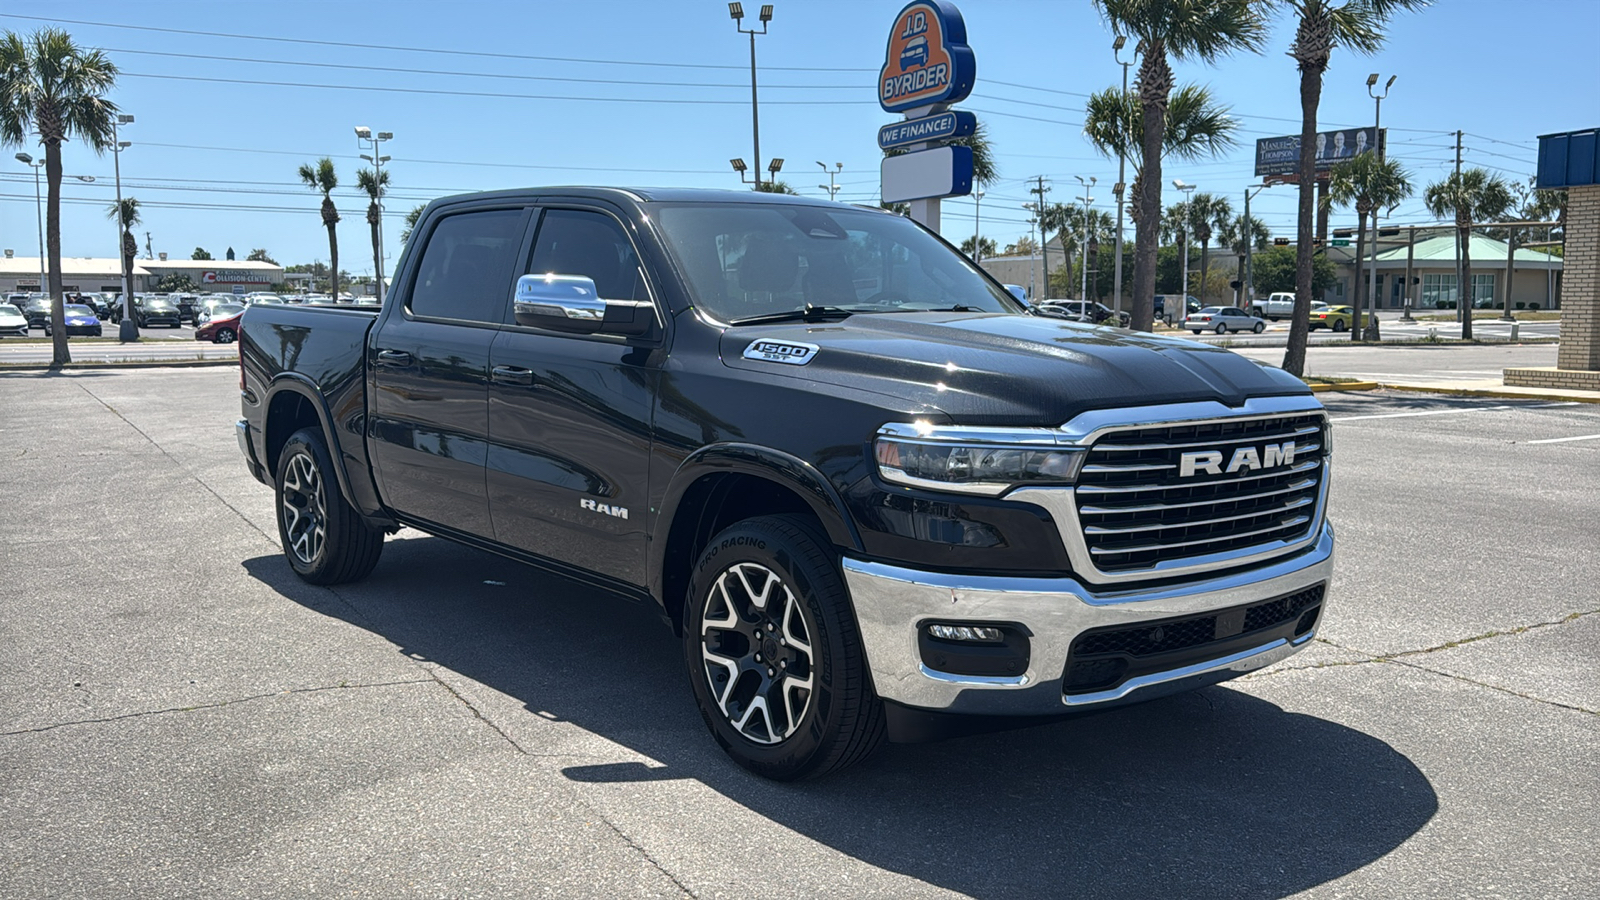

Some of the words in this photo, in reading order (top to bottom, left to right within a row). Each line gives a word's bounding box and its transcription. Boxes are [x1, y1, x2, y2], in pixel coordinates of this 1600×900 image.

[902, 12, 927, 38] J.D.
[883, 63, 947, 99] BYRIDER
[882, 129, 899, 142] WE
[900, 117, 952, 138] FINANCE!
[1260, 141, 1288, 151] MANUEL
[1260, 150, 1294, 160] THOMPSON
[203, 272, 246, 284] COLLISION
[247, 275, 271, 283] CENTER
[757, 343, 807, 357] 1500
[1180, 441, 1296, 477] RAM
[580, 498, 629, 520] RAM
[700, 546, 718, 572] PRO
[721, 536, 767, 550] RACING
